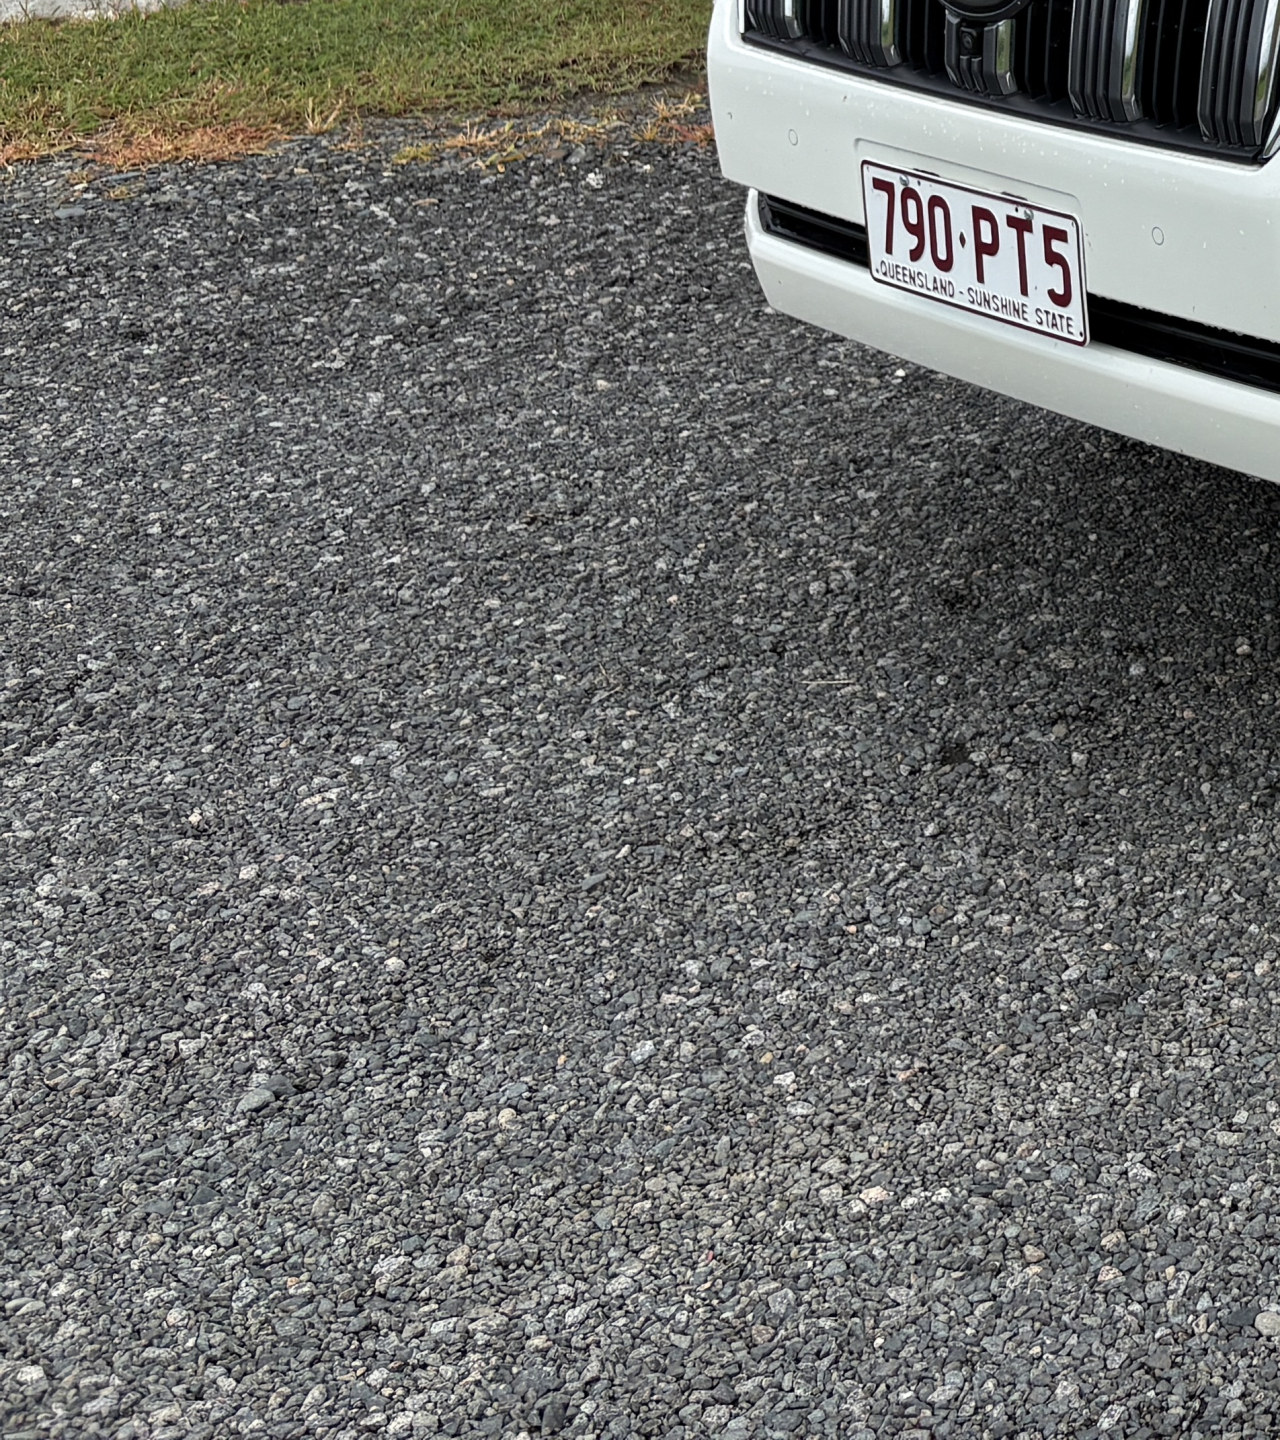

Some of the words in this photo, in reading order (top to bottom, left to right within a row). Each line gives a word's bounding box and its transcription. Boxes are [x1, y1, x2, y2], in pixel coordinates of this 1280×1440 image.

[872, 177, 954, 273] 790
[971, 205, 1072, 308] PT5
[880, 259, 955, 297] QUEENSLAND
[967, 287, 1029, 322] SUNSHINE
[1034, 307, 1075, 336] STATE
